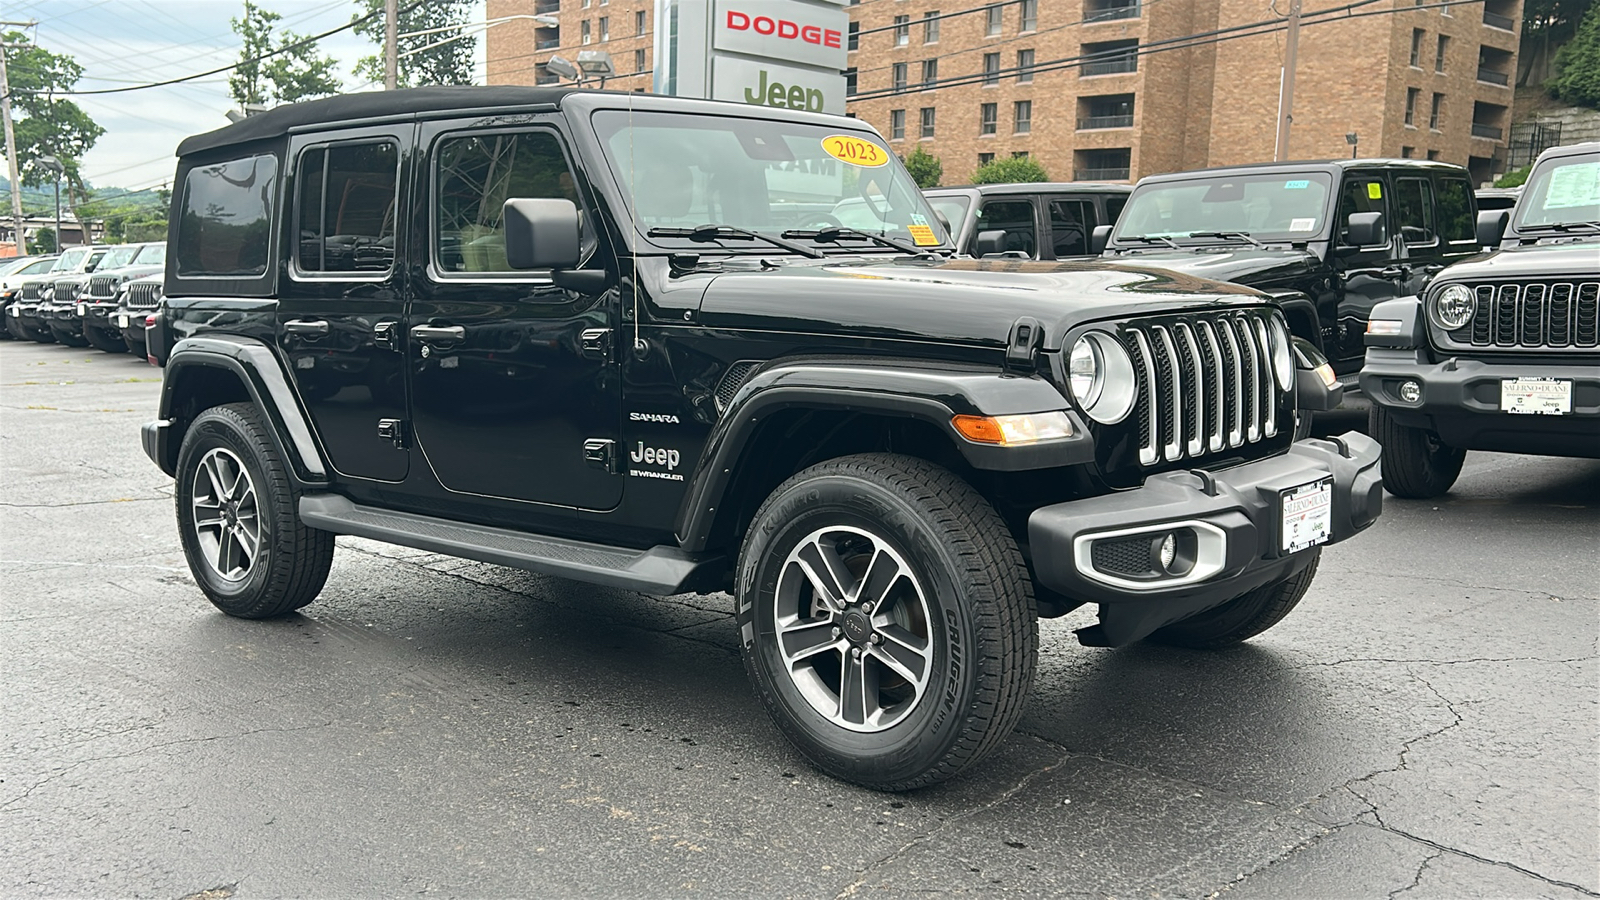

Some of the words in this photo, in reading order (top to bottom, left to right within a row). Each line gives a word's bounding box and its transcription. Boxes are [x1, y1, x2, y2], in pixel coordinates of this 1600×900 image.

[726, 10, 842, 49] DODGE
[744, 70, 825, 113] Jeep
[834, 140, 877, 161] 2023
[1504, 384, 1538, 392] SALERNO
[629, 412, 680, 424] SAHARA
[630, 441, 680, 471] Jeep
[637, 470, 684, 482] WRANGLER
[945, 608, 961, 713] CRUGEN
